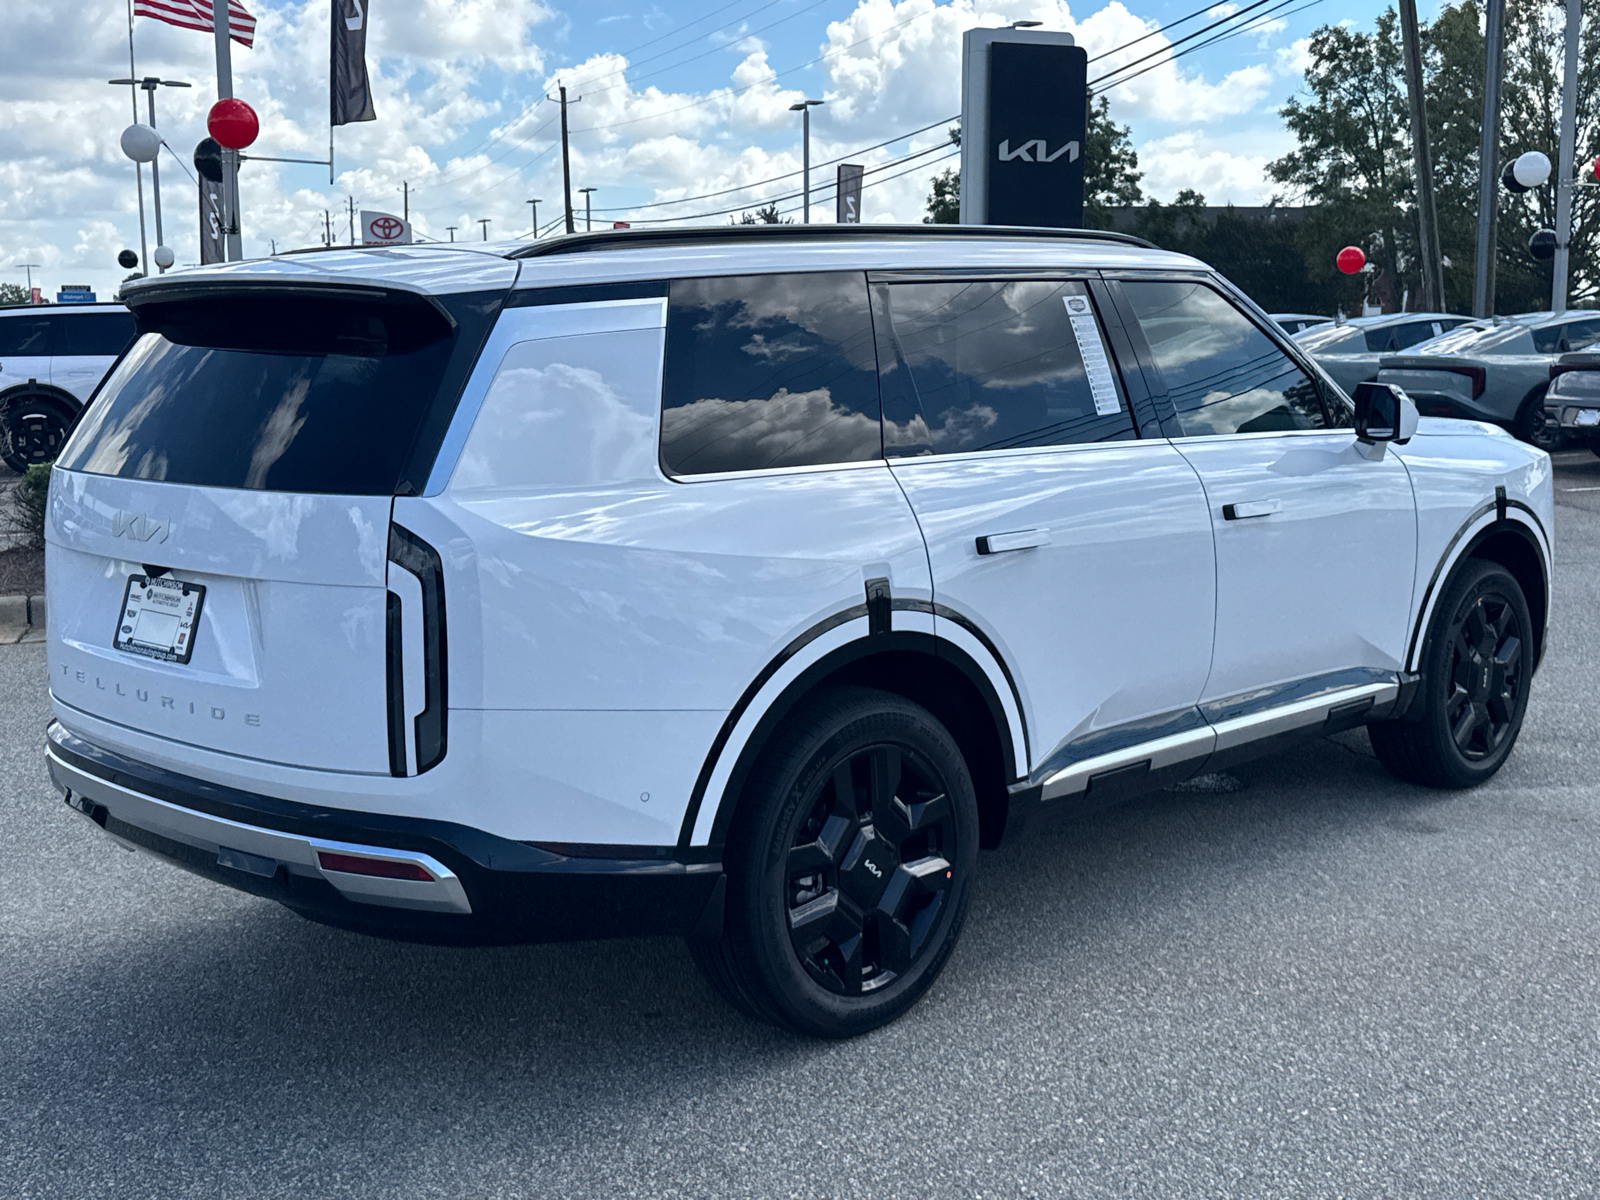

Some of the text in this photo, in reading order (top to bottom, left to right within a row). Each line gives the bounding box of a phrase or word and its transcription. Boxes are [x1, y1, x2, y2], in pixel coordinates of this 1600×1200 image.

[998, 138, 1080, 164] KIA
[111, 509, 172, 545] KIA
[151, 578, 183, 590] HUTCHINSON
[153, 592, 182, 603] HUTCHINSON
[60, 663, 260, 727] TELLURIDE
